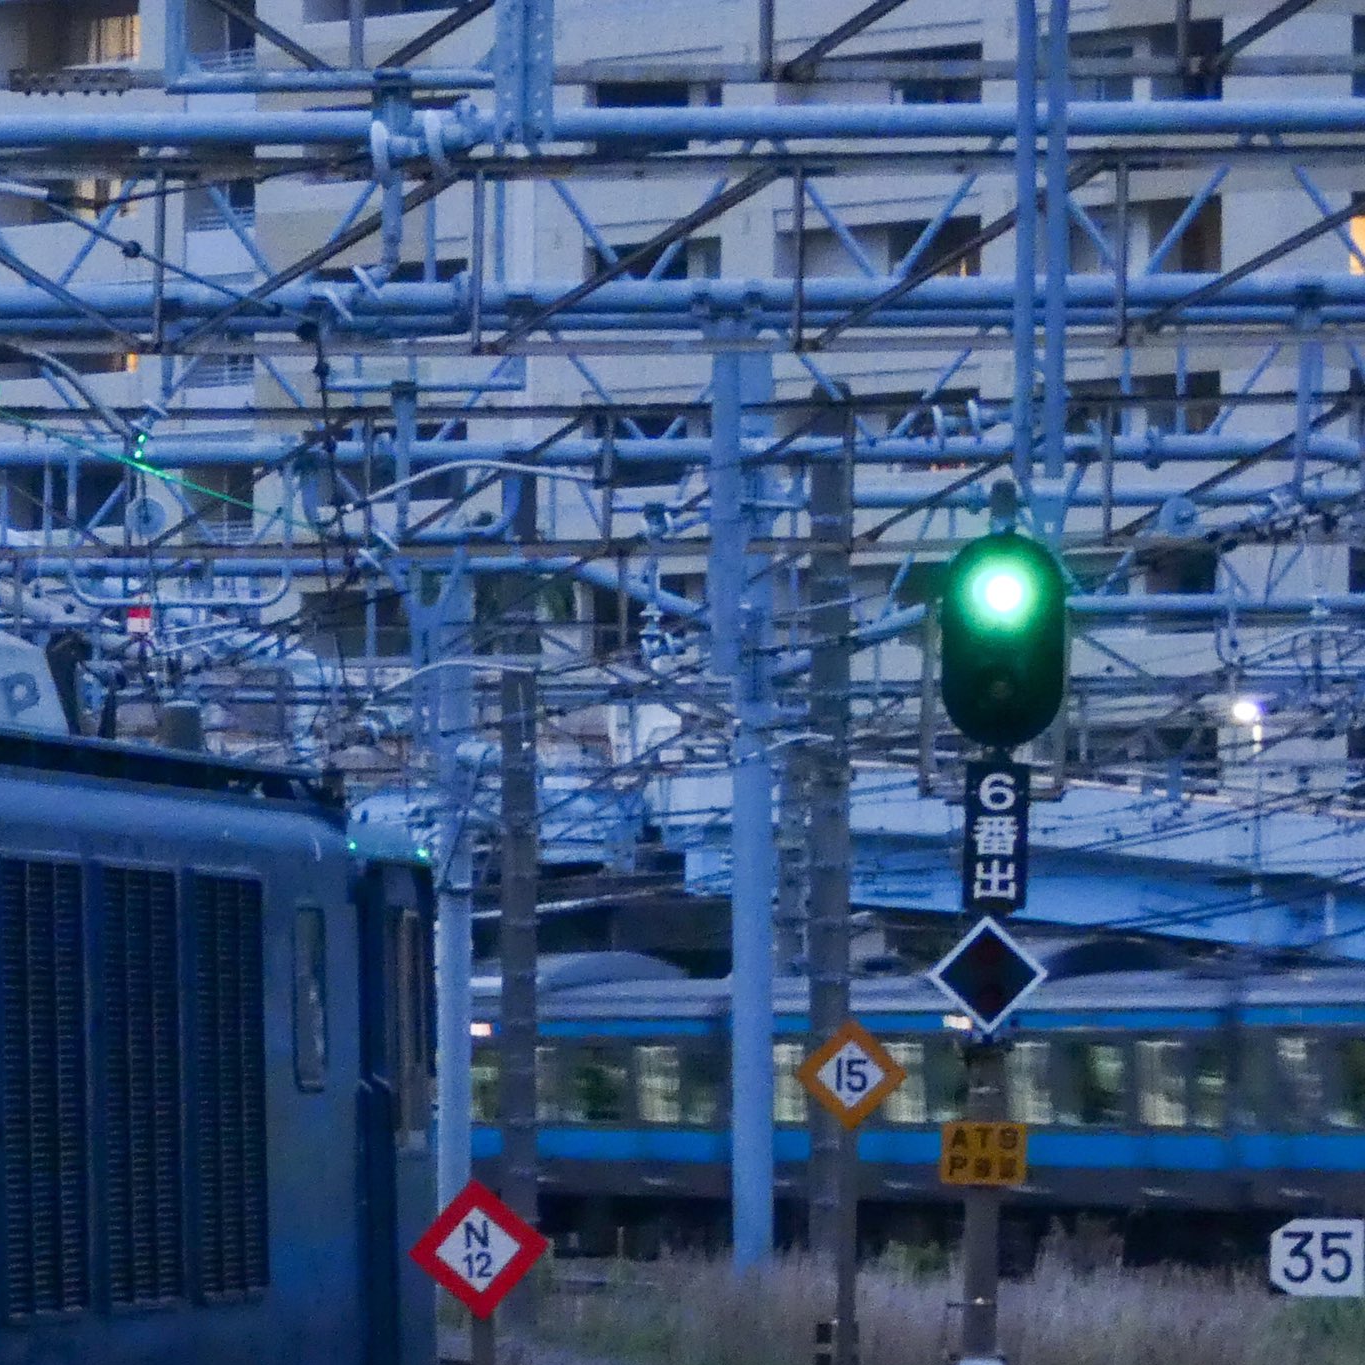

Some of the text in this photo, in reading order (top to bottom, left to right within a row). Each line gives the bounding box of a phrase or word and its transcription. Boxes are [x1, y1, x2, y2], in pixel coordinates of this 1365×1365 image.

[972, 772, 1020, 899] 6番出
[835, 1057, 869, 1093] 15
[462, 1220, 490, 1249] N
[461, 1251, 494, 1279] 12
[1282, 1230, 1354, 1284] 35
